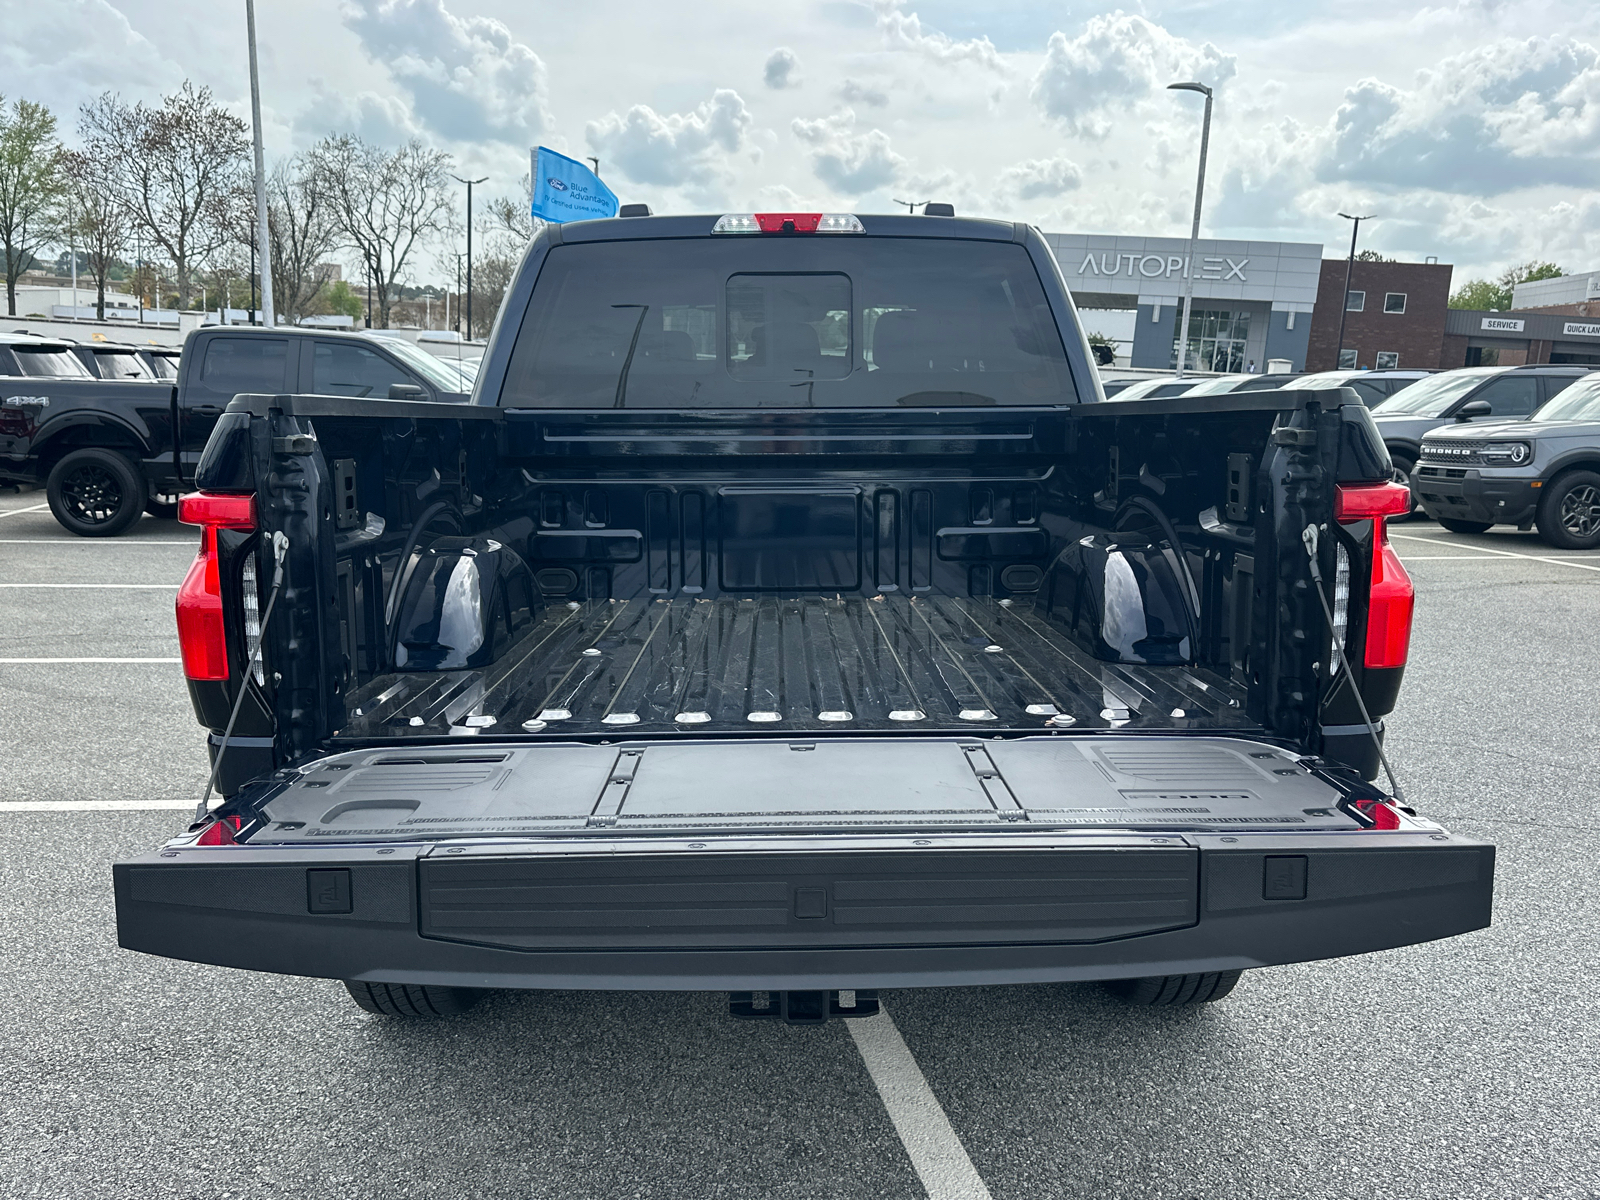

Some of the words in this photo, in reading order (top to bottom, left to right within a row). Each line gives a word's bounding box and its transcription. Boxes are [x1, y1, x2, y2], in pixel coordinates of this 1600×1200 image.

[571, 183, 588, 193] Blue
[551, 198, 572, 209] Certified
[570, 192, 609, 207] Advantage
[1078, 253, 1249, 281] AUTOPLEX
[1488, 320, 1518, 329] SERVICE
[1566, 324, 1587, 334] QUICK
